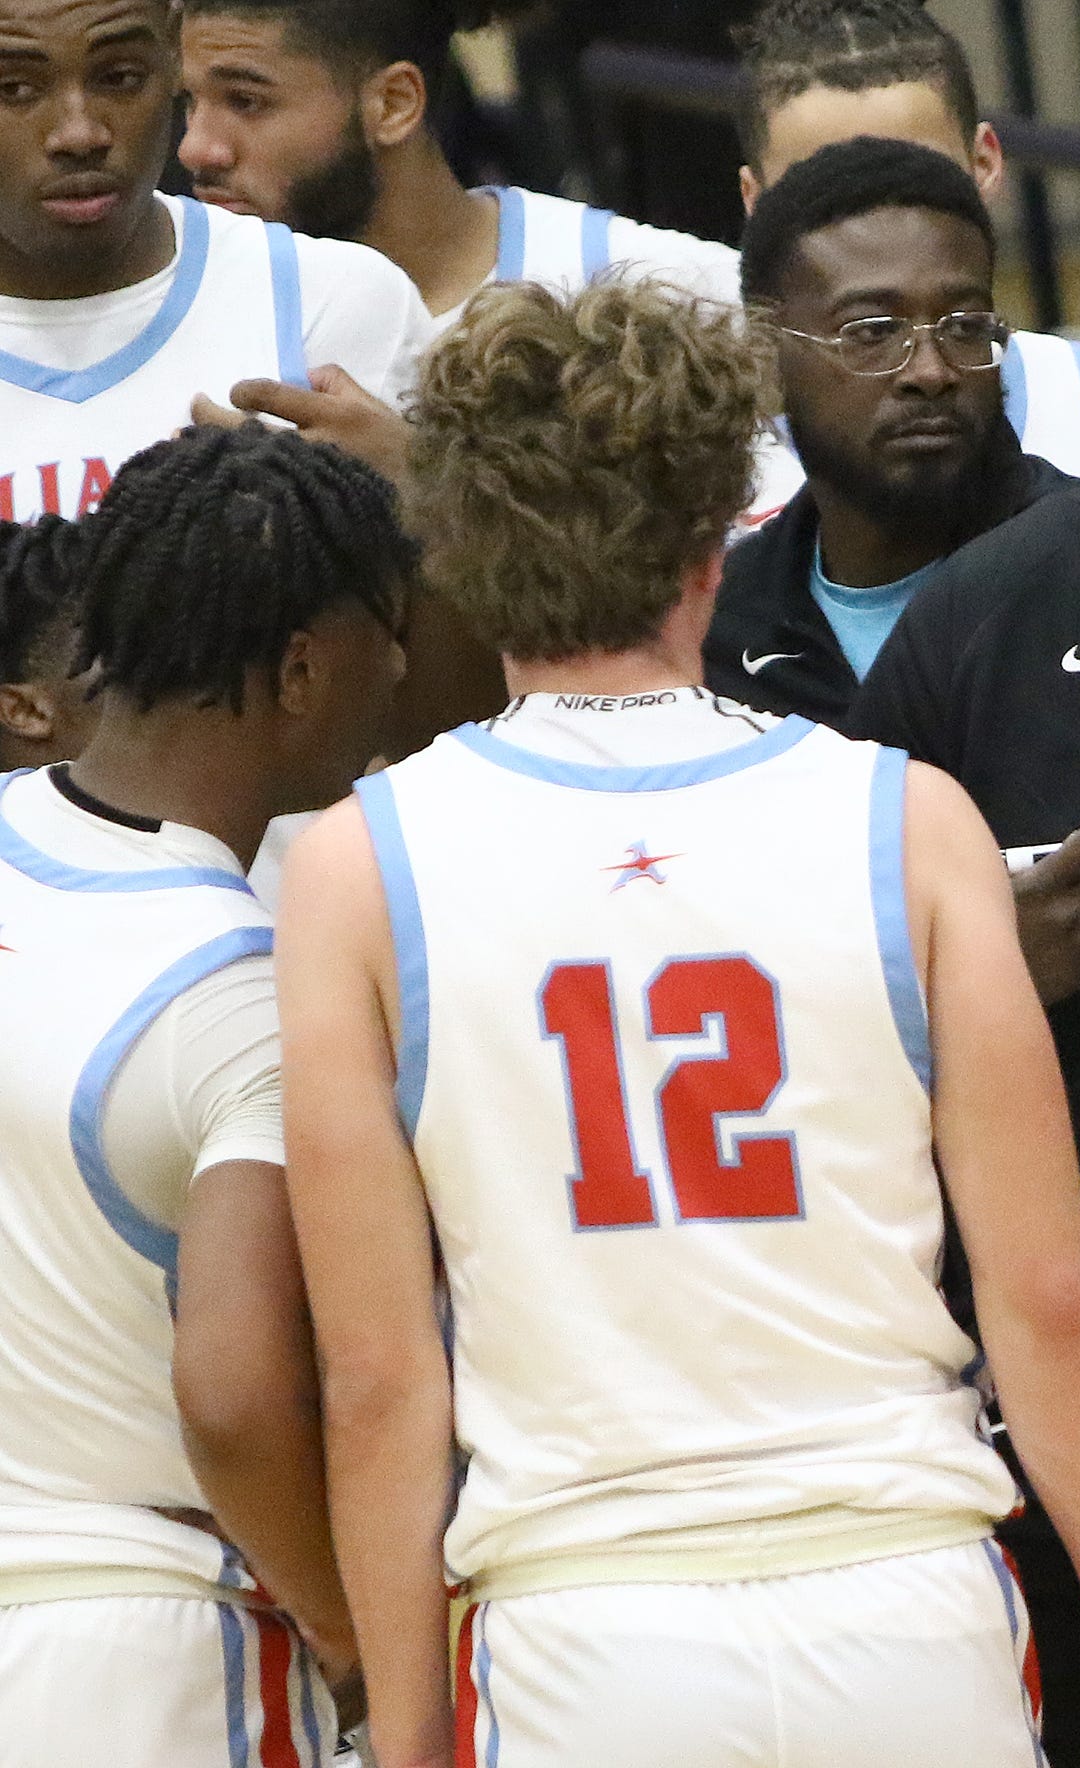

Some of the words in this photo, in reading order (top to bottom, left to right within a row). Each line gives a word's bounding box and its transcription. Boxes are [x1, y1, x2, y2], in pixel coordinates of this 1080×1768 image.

[554, 694, 617, 712] NIKE
[620, 691, 677, 711] PRO
[535, 951, 807, 1233] 12
